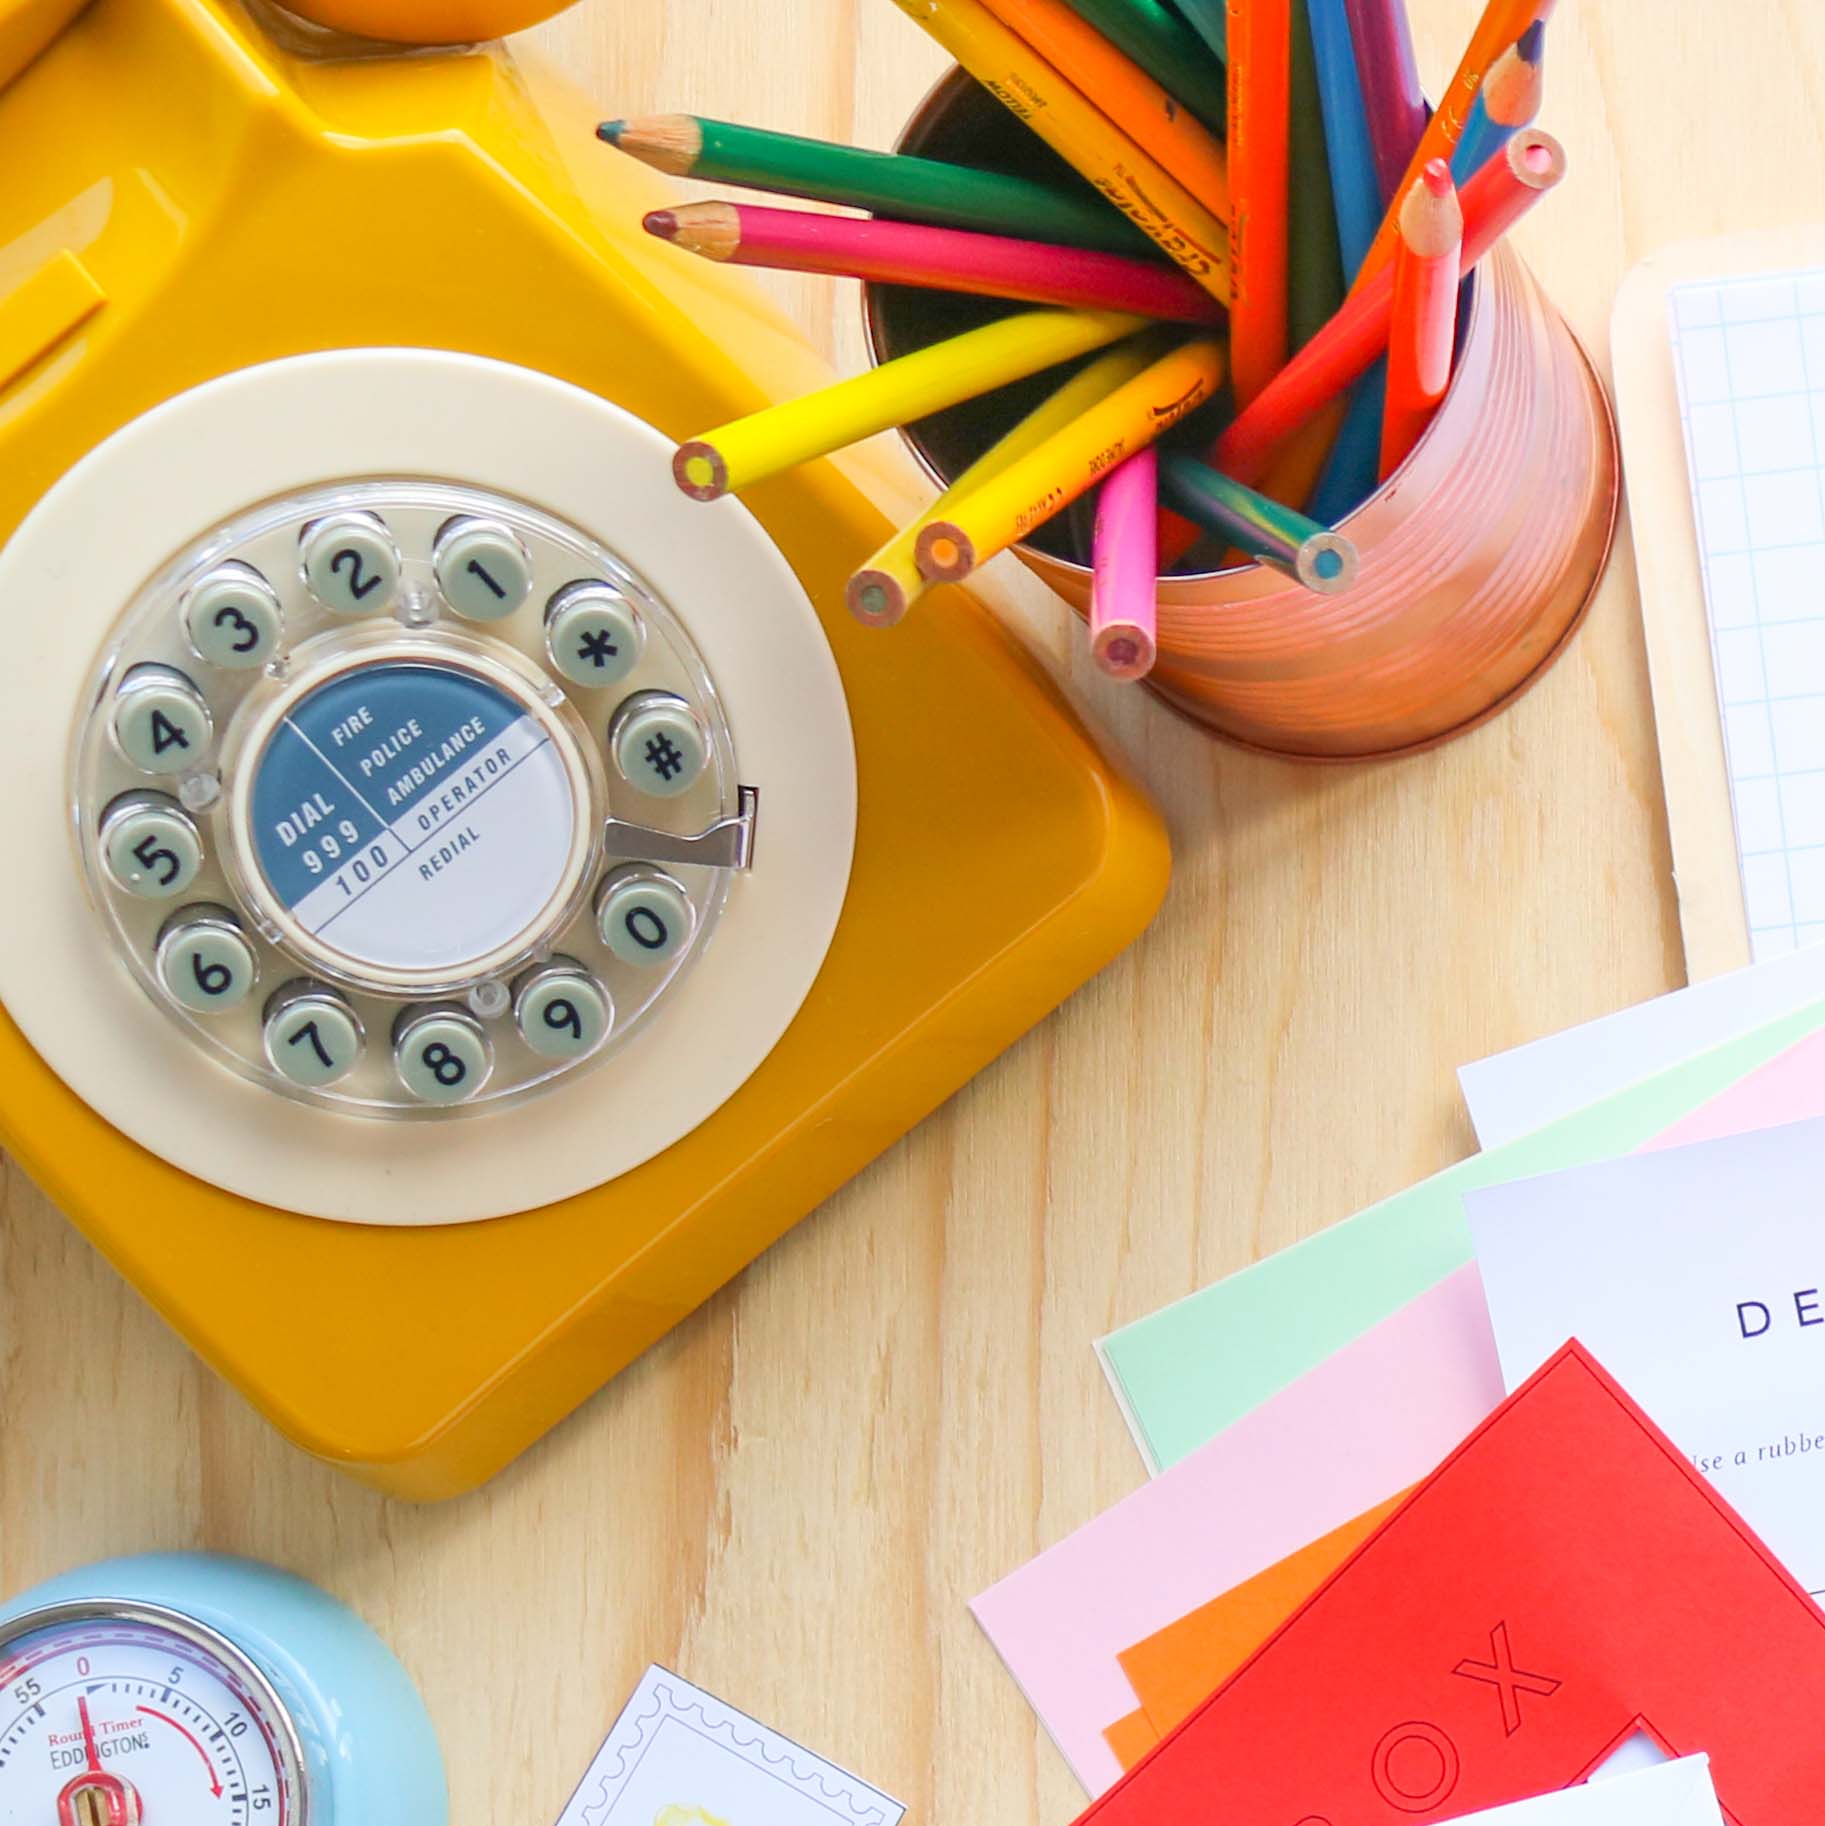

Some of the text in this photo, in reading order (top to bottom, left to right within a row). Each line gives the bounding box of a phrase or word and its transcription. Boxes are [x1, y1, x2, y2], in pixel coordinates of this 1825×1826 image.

[329, 548, 383, 601] 2
[466, 559, 507, 600] 1
[213, 606, 260, 653] 3
[151, 709, 190, 755] 4
[331, 706, 374, 747] FIRE
[359, 718, 424, 777] POLICE
[386, 716, 487, 806] AMBULANCE
[417, 748, 513, 832] OPERATOR
[275, 792, 335, 847] DIAL
[131, 834, 181, 887] 5
[302, 819, 359, 875] 999
[418, 825, 481, 881] REDIAL
[335, 845, 389, 896] 100
[624, 906, 668, 950] 0
[192, 952, 233, 996] 6
[542, 998, 582, 1040] 9
[287, 1020, 334, 1069] 7
[421, 1042, 467, 1087] 8
[1734, 1451, 1746, 1466] a
[76, 1656, 90, 1676] 0
[167, 1666, 185, 1686] 5
[14, 1678, 42, 1705] 55
[99, 1718, 144, 1735] Timer
[223, 1711, 248, 1738] 10
[251, 1784, 272, 1811] 15
